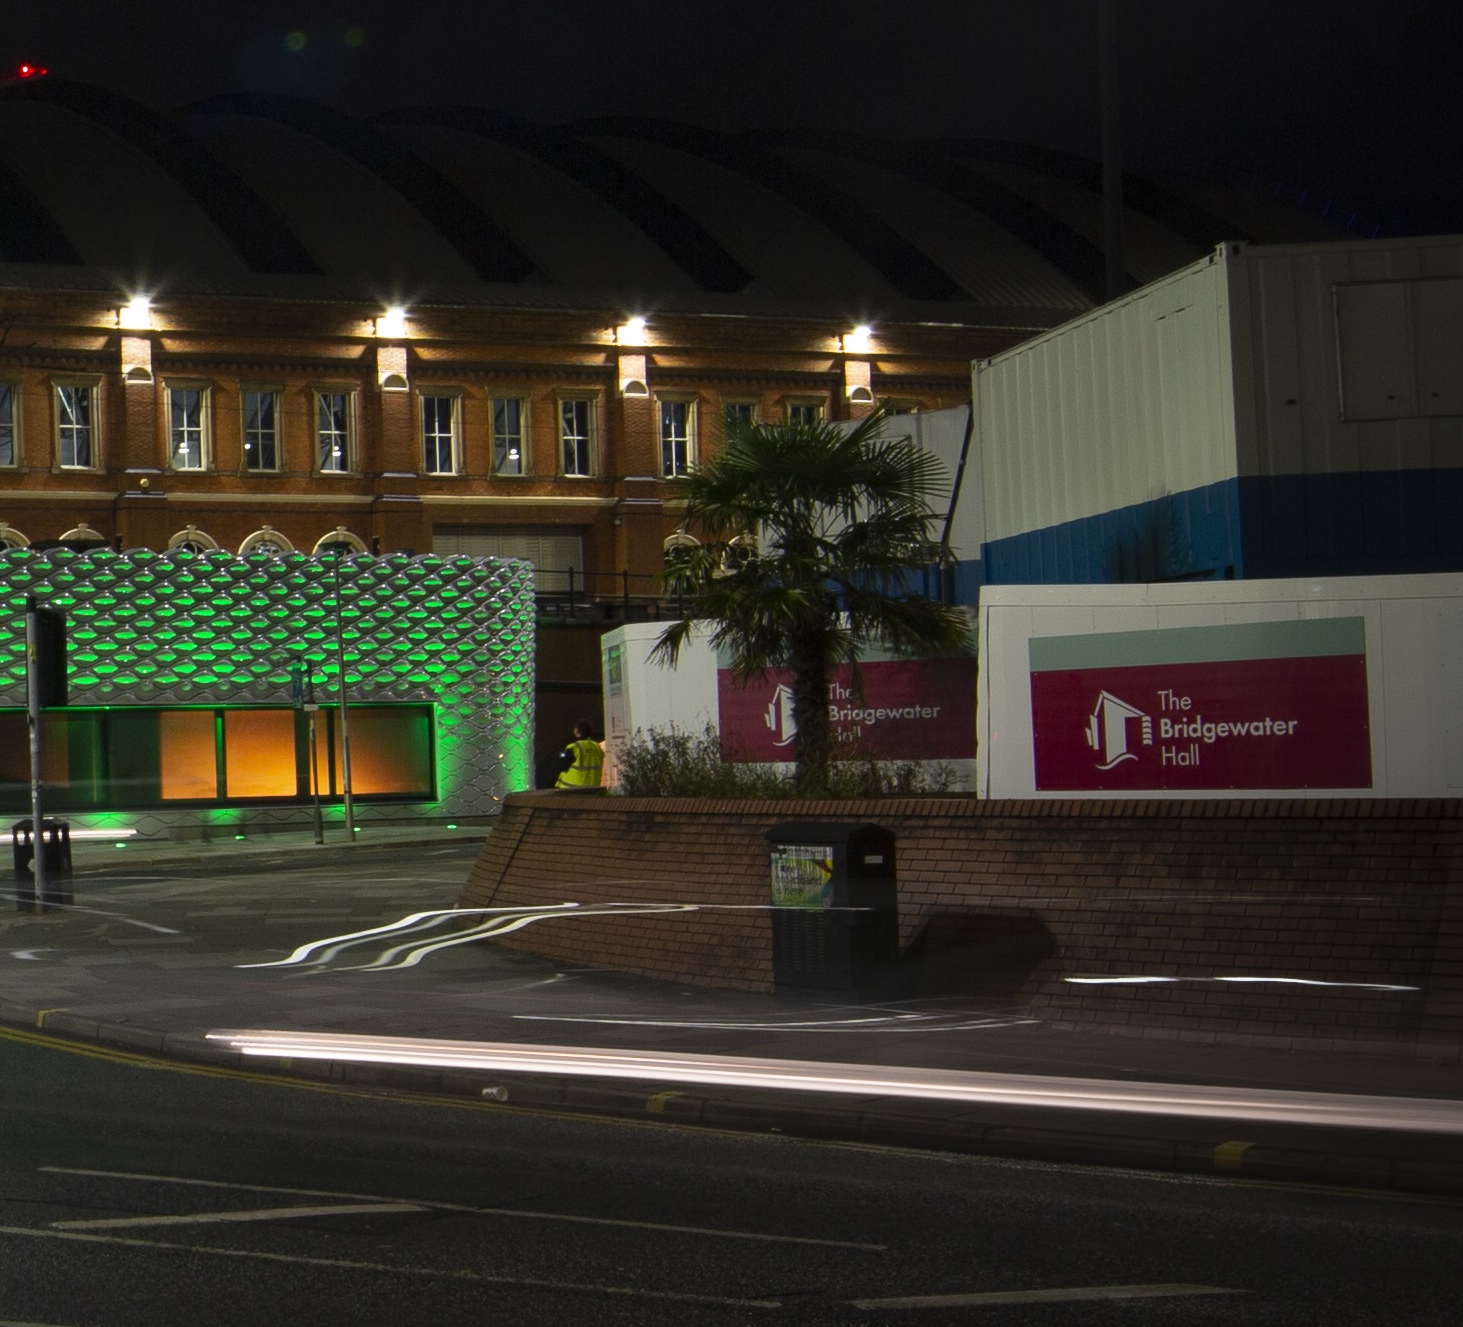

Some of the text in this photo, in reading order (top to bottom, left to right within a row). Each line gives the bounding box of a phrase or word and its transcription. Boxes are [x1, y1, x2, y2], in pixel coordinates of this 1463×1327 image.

[1157, 688, 1192, 711] The
[1160, 715, 1298, 744] Bridgewater
[1161, 743, 1200, 766] Hall
